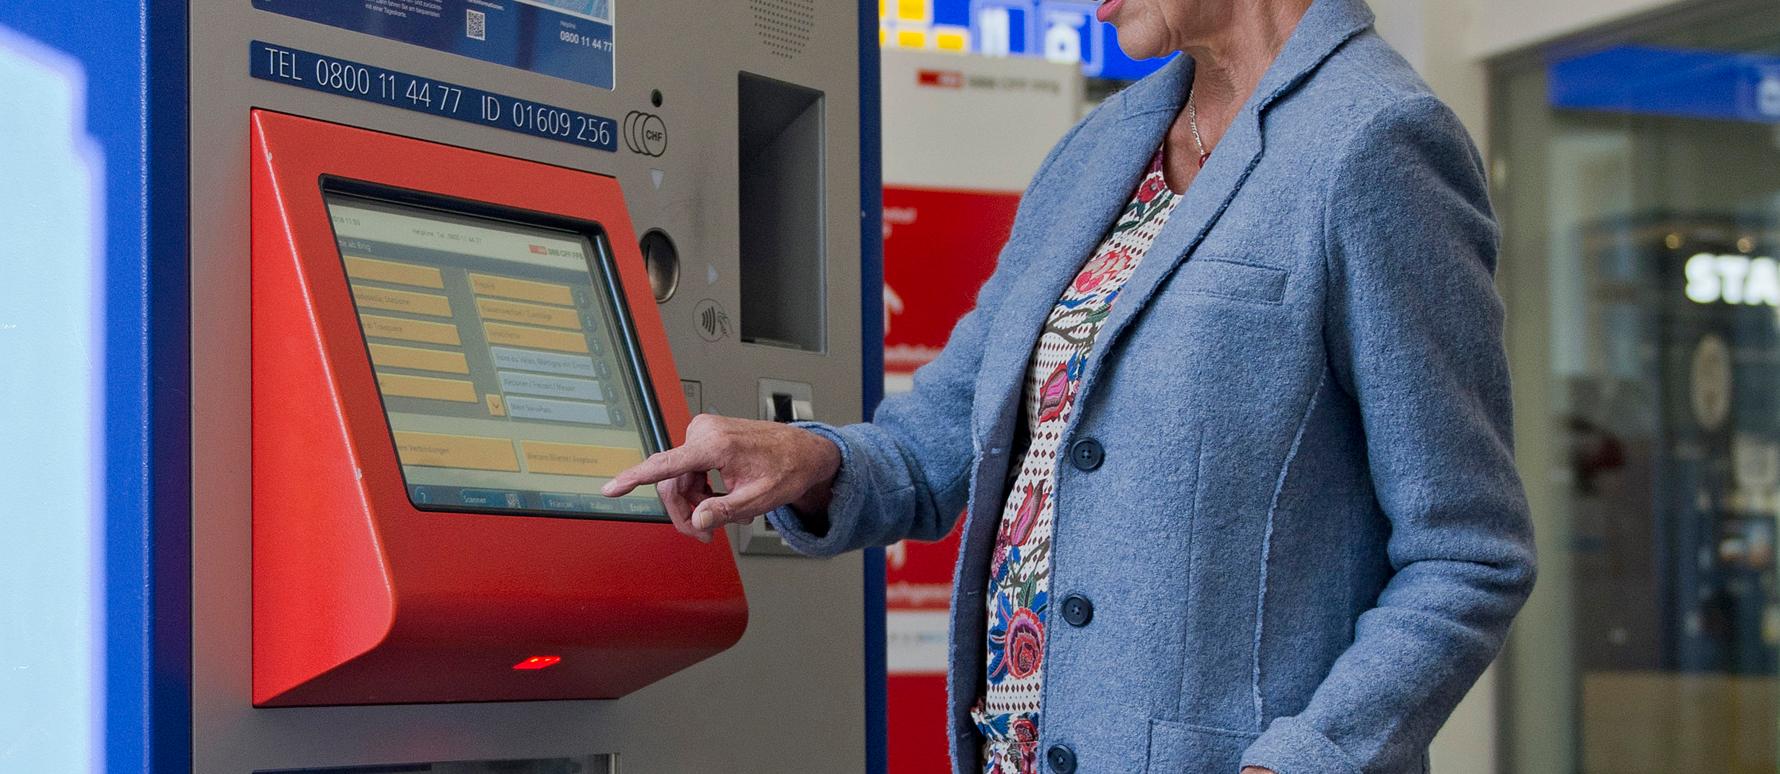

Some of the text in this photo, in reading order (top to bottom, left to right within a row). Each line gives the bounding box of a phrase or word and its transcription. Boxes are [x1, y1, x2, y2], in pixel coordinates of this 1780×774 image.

[559, 30, 613, 52] 0800 11 44 77
[264, 47, 610, 145] TEL 0800 11 44 77 ID 01609 256
[645, 129, 663, 142] CHF
[1684, 252, 1780, 306] STA
